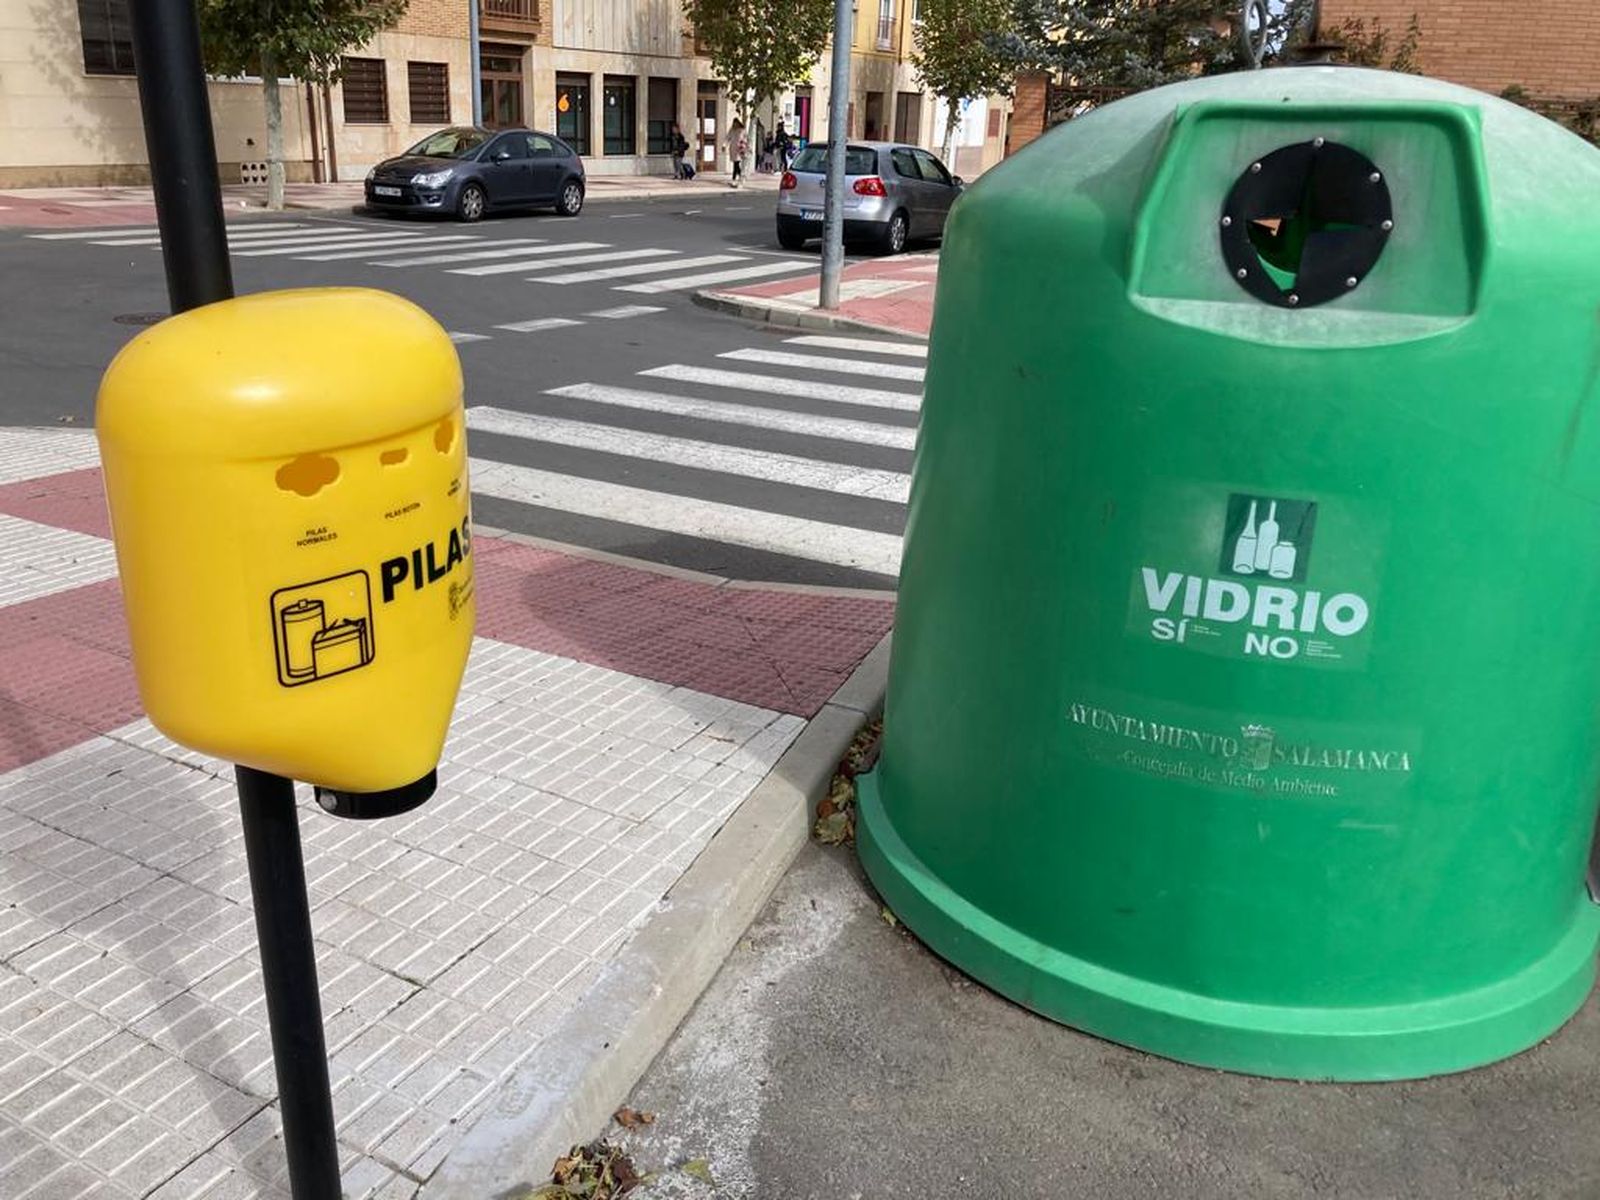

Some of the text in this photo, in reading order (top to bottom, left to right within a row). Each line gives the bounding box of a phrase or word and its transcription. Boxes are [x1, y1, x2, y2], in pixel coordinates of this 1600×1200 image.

[296, 532, 338, 547] NORMALES
[305, 526, 327, 537] PILAS
[381, 514, 471, 603] PILAS
[1141, 567, 1369, 637] VIDRIO
[1151, 617, 1188, 643] SÍ
[1243, 632, 1299, 659] NO
[1066, 702, 1411, 772] AYUNTAMIENTO SALAMANCA
[1198, 767, 1215, 782] de
[1221, 771, 1265, 789] Medio
[1271, 777, 1338, 796] Ambiente
